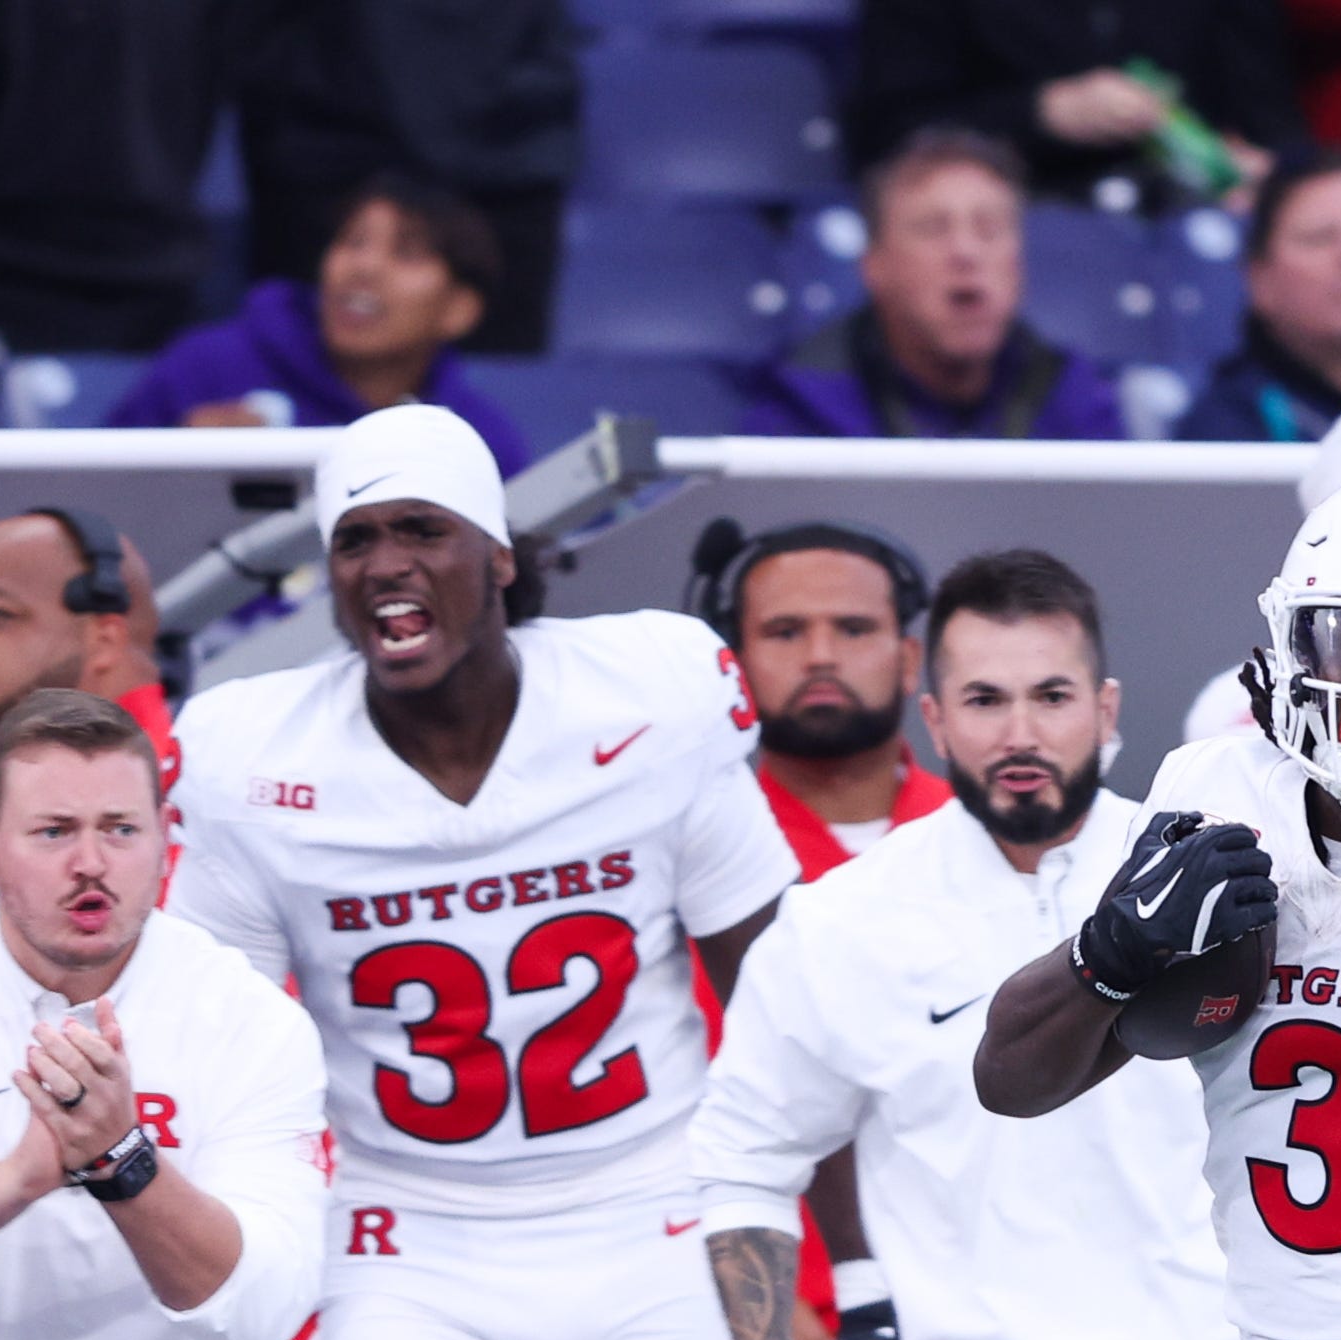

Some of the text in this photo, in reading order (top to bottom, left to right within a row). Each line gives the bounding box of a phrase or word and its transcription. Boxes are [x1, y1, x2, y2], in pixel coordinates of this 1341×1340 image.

[717, 647, 757, 730] 3
[325, 851, 635, 931] RUTGERS
[1095, 981, 1131, 1000] CHOP
[1194, 994, 1240, 1027] R
[350, 910, 649, 1143] 32
[134, 1093, 181, 1148] R
[347, 1206, 400, 1255] R
